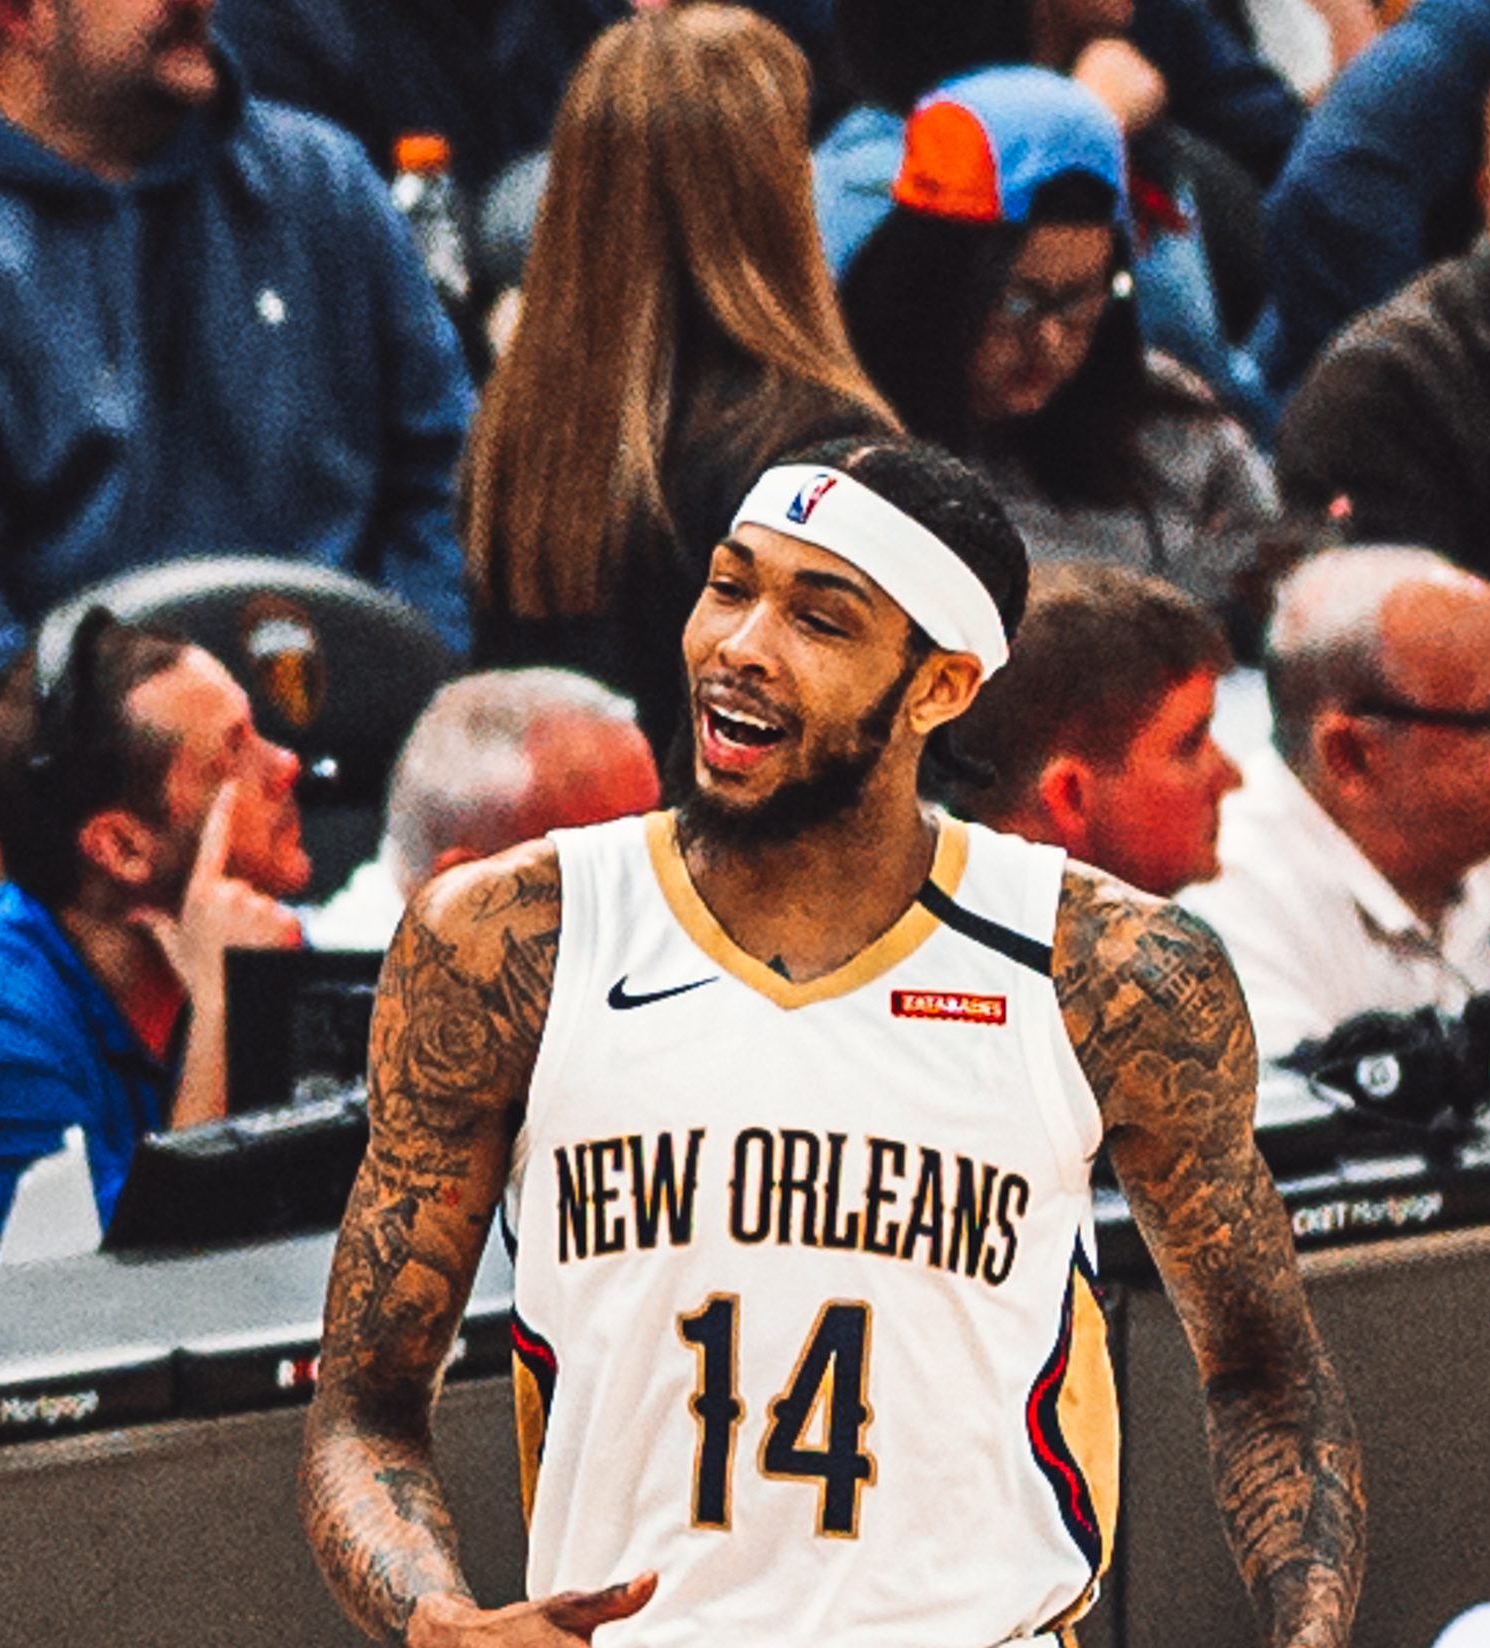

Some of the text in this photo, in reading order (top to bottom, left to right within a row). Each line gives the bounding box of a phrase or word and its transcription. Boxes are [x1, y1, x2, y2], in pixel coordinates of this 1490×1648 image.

[554, 1126, 1031, 1288] NEW ORLEANS
[1292, 1200, 1347, 1236] CKET
[1, 1389, 100, 1425] Mortgage
[677, 1291, 879, 1541] 14
